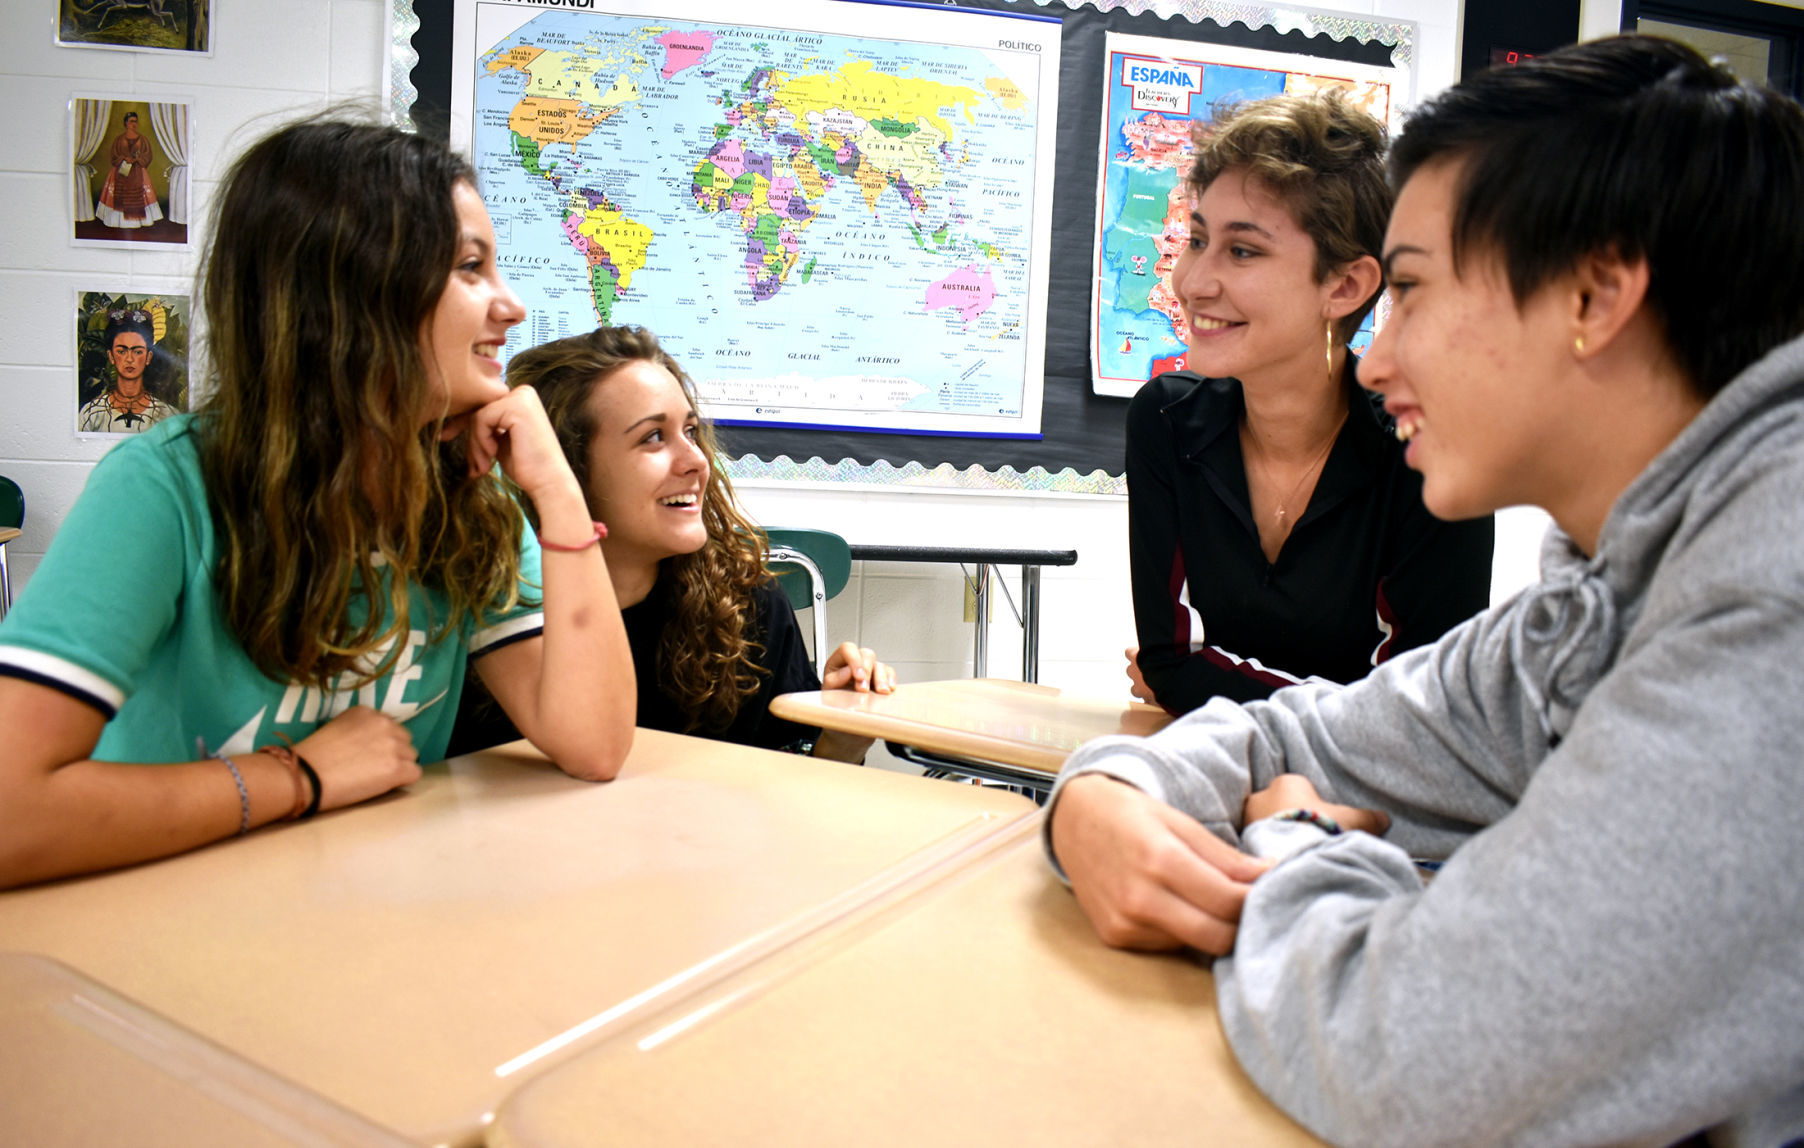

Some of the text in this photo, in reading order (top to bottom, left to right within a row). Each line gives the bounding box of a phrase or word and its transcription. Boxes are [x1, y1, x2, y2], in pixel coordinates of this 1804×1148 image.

[717, 28, 822, 44] OCÉANO GLACIAL ÁRTICO
[669, 44, 704, 52] GROENLANDIA
[998, 40, 1042, 52] POLÍTICO
[1131, 66, 1194, 88] ESPAÑA
[842, 95, 886, 104] RUSIA
[538, 110, 567, 118] ESTADOS
[867, 143, 904, 152] CHINA
[484, 194, 527, 204] CÉANO
[596, 228, 644, 237] BRASIL
[496, 255, 551, 264] ACÍFICO
[942, 284, 980, 292] AUSTRALIA
[716, 348, 751, 357] OCÉANO
[788, 352, 822, 361] GLACIAL
[855, 355, 900, 364] ANTÁRTICO
